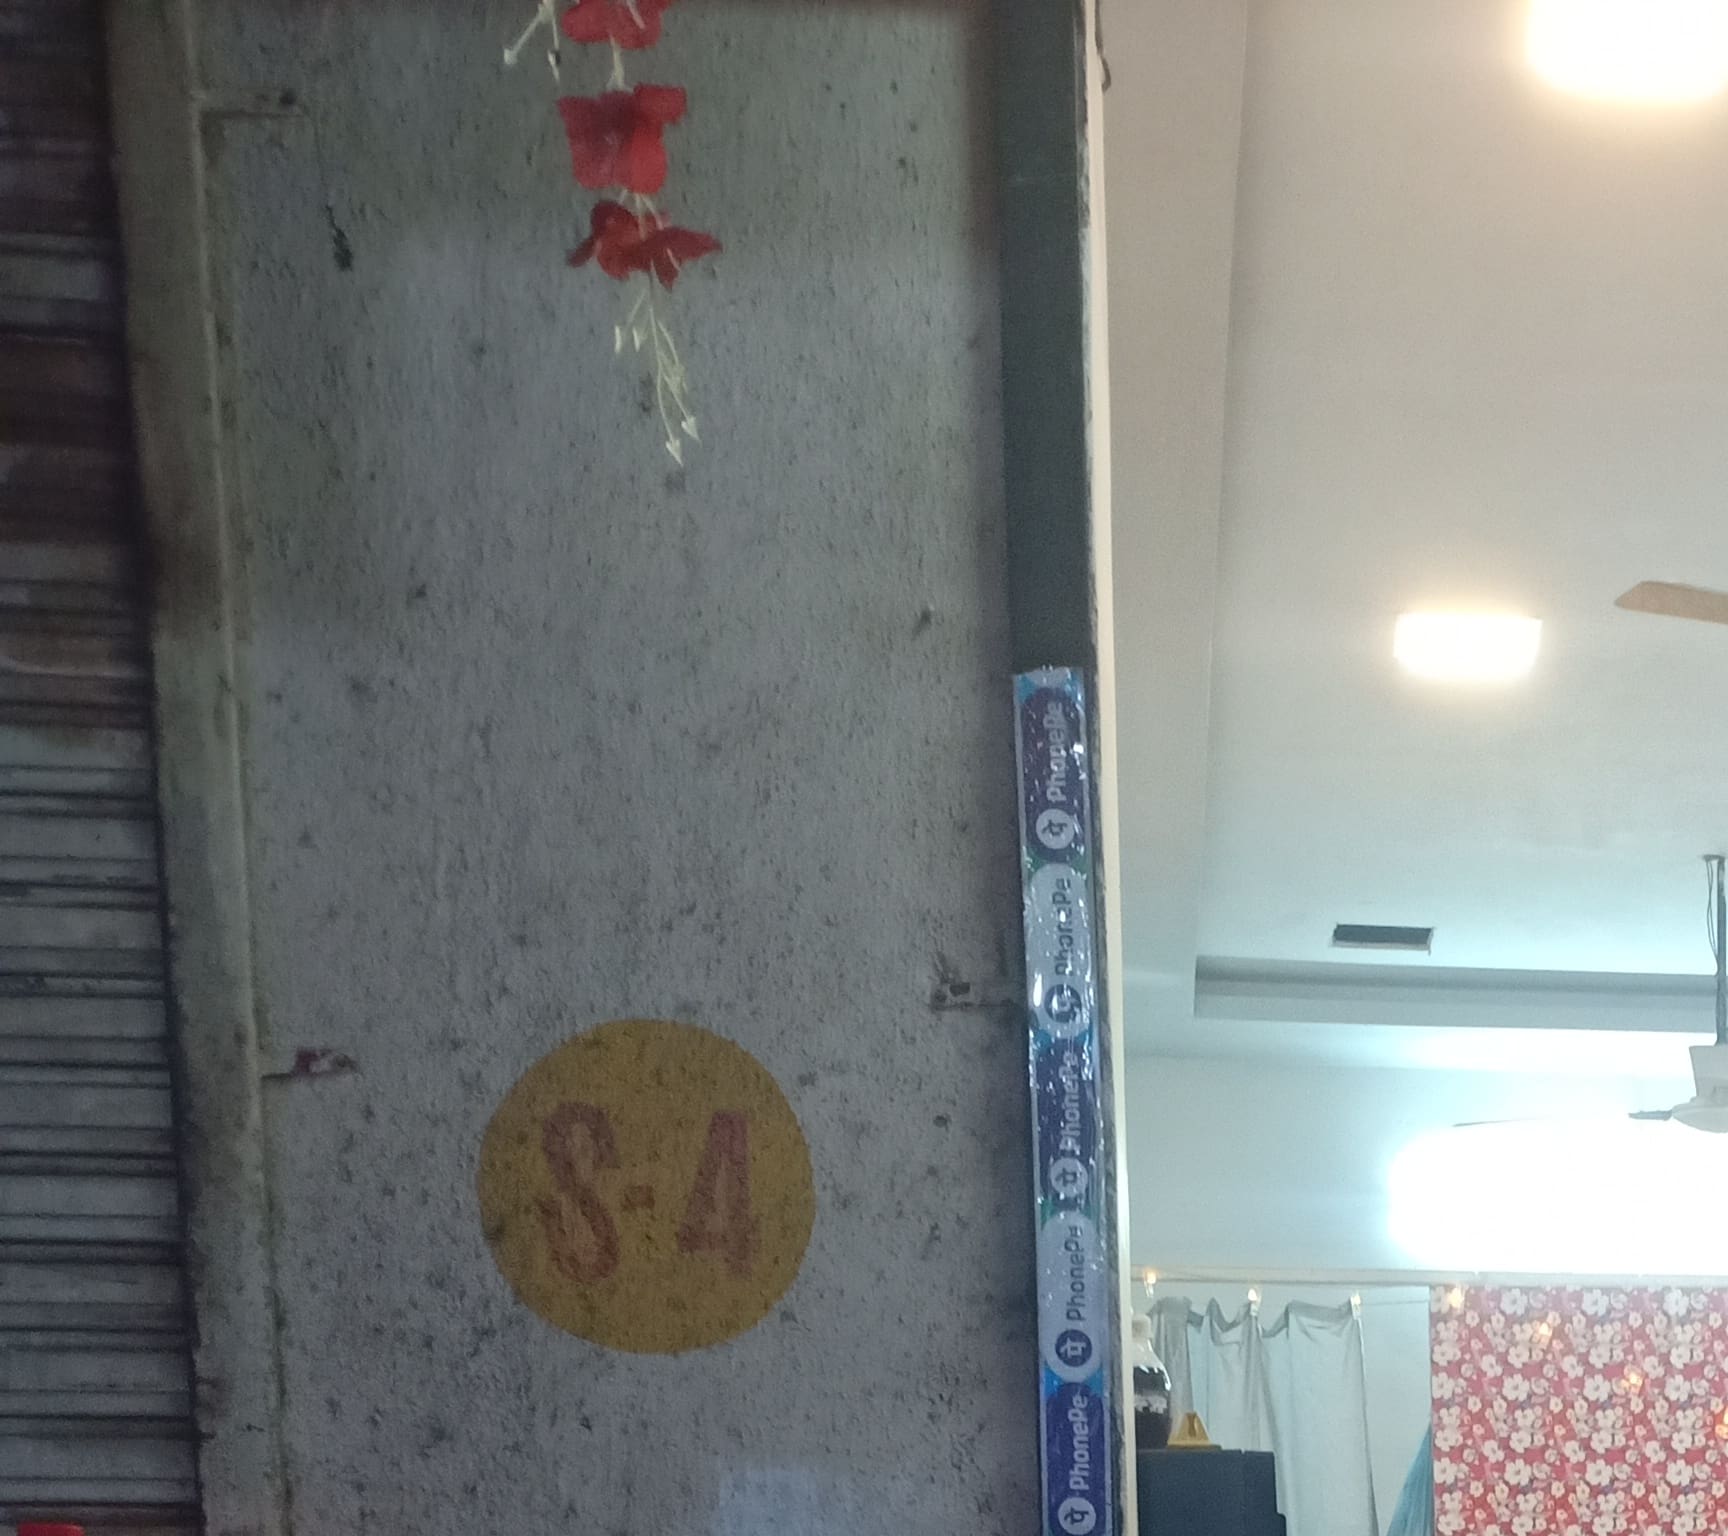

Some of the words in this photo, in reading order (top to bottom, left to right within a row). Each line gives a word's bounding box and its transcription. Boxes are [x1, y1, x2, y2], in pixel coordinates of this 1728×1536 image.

[1044, 700, 1068, 803] PhonePe
[1065, 1225, 1087, 1322] PhonePe
[1068, 1394, 1090, 1491] PhonePe
